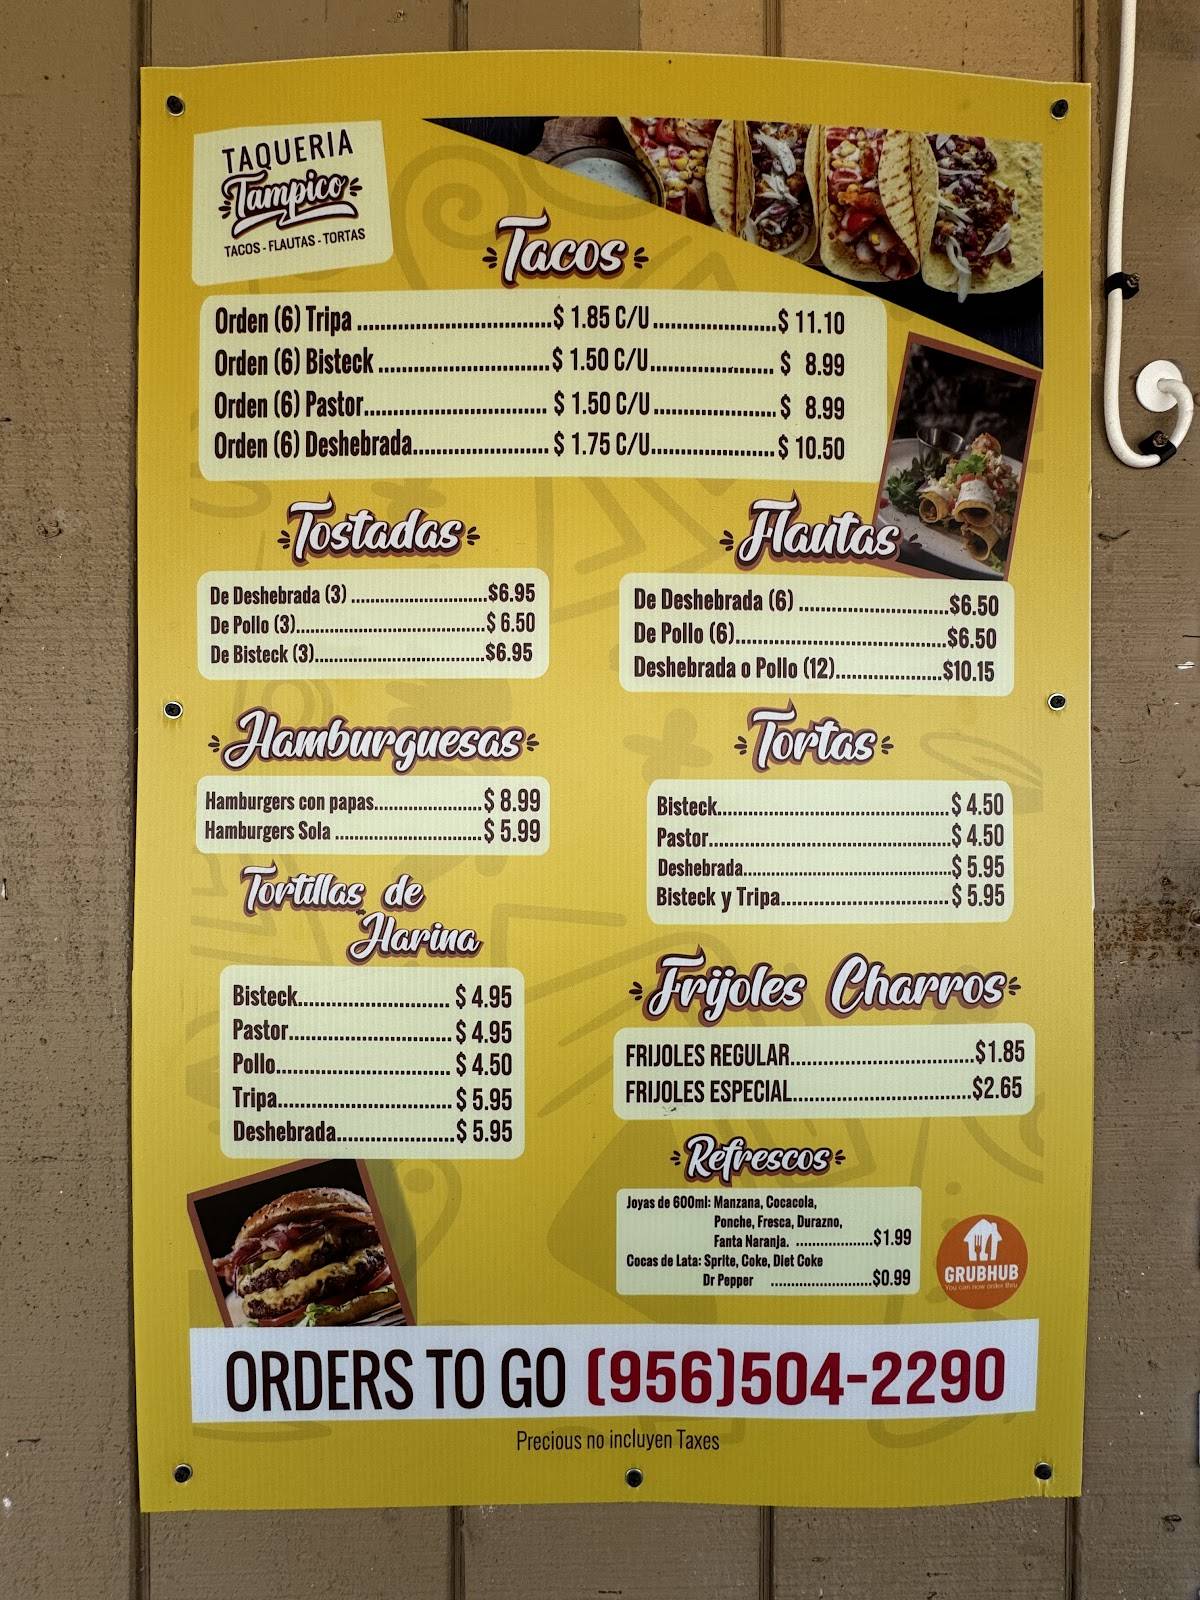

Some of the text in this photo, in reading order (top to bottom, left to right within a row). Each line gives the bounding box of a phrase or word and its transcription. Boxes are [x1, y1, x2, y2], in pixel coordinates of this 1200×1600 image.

[222, 129, 353, 173] TAQUERIA
[222, 170, 348, 219] Tampico
[224, 228, 365, 257] TACOS FLAUTAS TORTAS
[498, 210, 628, 286] Tacos
[216, 304, 844, 336] Orden (6) Tripa $ 1.85 C/U $ 11.10
[215, 346, 844, 376] Orden (6) Bisteck $ 1.50 C/U $ 8.99
[215, 390, 844, 420] Orden (6) Pastor $ 1.50 C/U $ 8.99
[215, 429, 844, 460] Orden (6) Deshebrada $ 1.75 C/U $ 10.50
[289, 499, 465, 562] Tostadas
[737, 496, 900, 566] Flautas
[211, 583, 535, 605] De Deshebrada (3) $6.95
[635, 588, 998, 616] De Deshebrada (6) $6.50
[211, 611, 535, 634] De Pollo (3) $ 6.50
[635, 622, 996, 649] De Pollo (6) $6.50
[211, 642, 532, 663] De Bisteck (3) $6.95
[635, 656, 994, 682] Deshebrada o Pollo (12) $10.15
[222, 710, 525, 774] Hamburguesas
[750, 705, 879, 771] Tortas
[206, 788, 540, 814] Hamburgers con papas $ 8.99
[658, 792, 1003, 817] Bisteck $ 4.50
[205, 818, 540, 843] Hamburgers Sola $ 5.99
[658, 823, 1004, 848] Pastor $ 4.50
[659, 854, 1004, 879] Deshebrada $ 5.95
[243, 865, 424, 915] Tortillas de
[657, 883, 1004, 913] Bisteck y Tripa $ 5.95
[348, 912, 481, 963] Harina
[234, 984, 511, 1009] Bisteck $ 4.95
[646, 952, 1006, 1024] Frijoles Charros
[234, 1019, 511, 1044] Pastor $ 4.95
[234, 1052, 512, 1077] Pollo $ 4.50
[627, 1040, 1024, 1067] FRIJOLES REGULAR $1.85
[233, 1087, 512, 1112] Tripa $ 5.95
[626, 1076, 1022, 1103] FRIJOLES ESPECIAL $2.65
[234, 1119, 512, 1143] Deshebrada $ 5.95
[686, 1136, 832, 1183] Refrescos
[627, 1195, 816, 1210] Joyas de 600ml: Manzana, Cocacola,
[715, 1215, 842, 1229] Ponche, Fresca, Durazno,
[714, 1235, 742, 1247] Fanta
[874, 1228, 911, 1247] $1.99
[627, 1254, 658, 1267] Cocas
[661, 1254, 673, 1266] de
[677, 1254, 701, 1267] Lata:
[704, 1254, 738, 1269] Sprite,
[742, 1254, 770, 1268] Coke,
[797, 1254, 823, 1267] Coke
[945, 1264, 1018, 1283] GRUBHUB
[703, 1269, 910, 1288] Dr Pepper $0.99
[227, 1348, 1005, 1412] ORDERS TO GO (956)504-2290
[518, 1428, 719, 1451] Precious no incluyen Taxes
